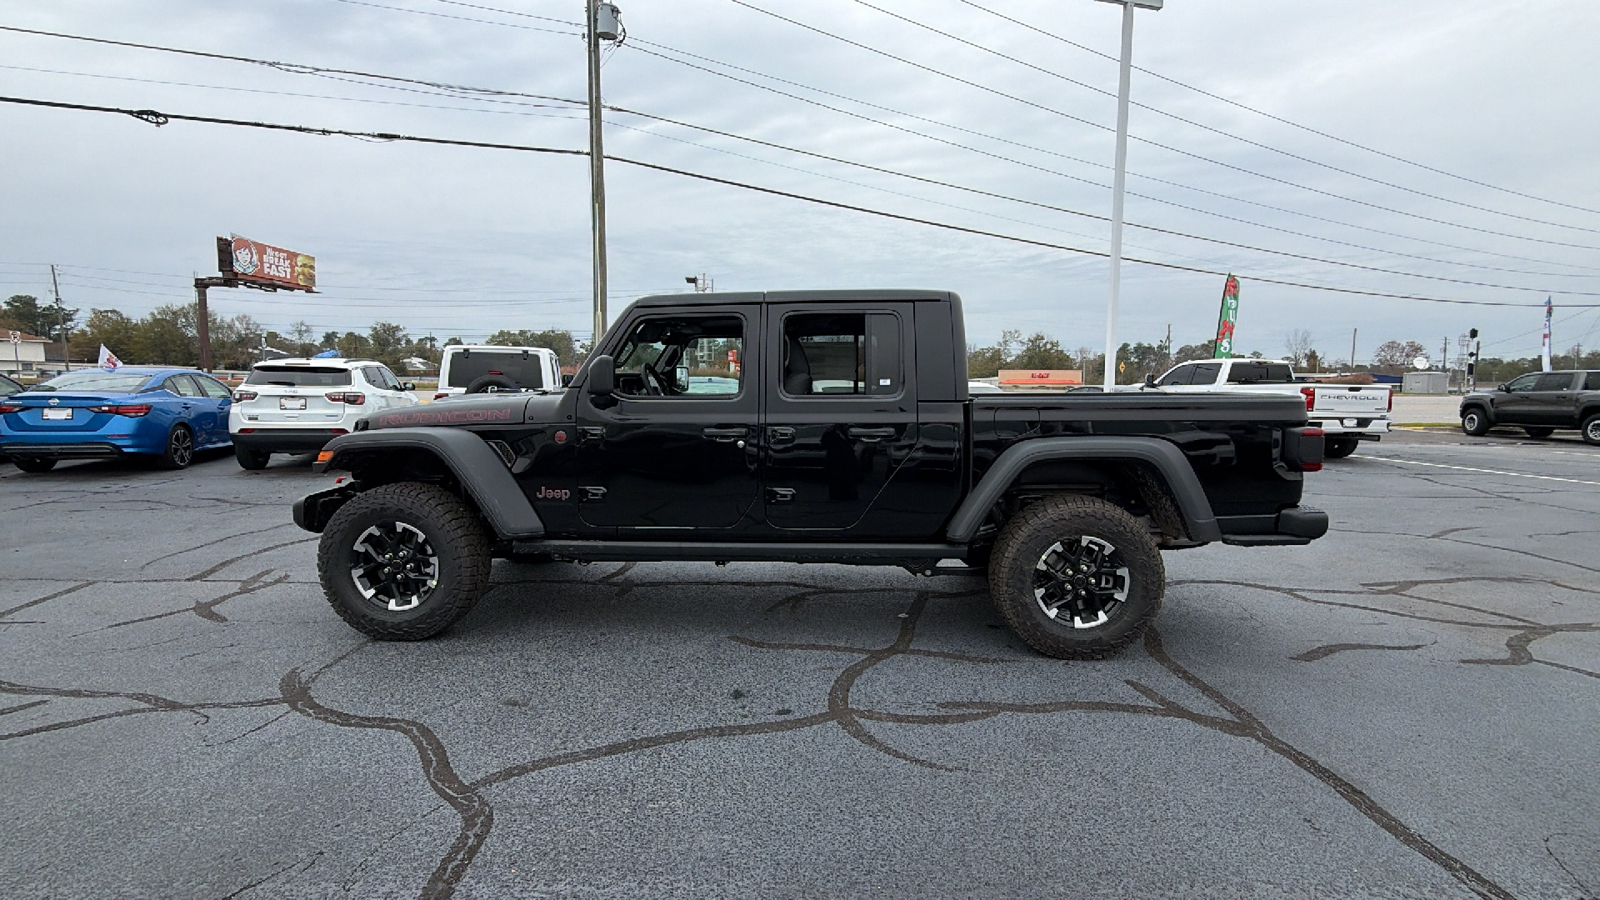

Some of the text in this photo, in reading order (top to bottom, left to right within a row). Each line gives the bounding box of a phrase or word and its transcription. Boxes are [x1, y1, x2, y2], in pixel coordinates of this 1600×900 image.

[263, 255, 290, 268] BREAK
[264, 263, 291, 278] FAST
[379, 408, 511, 426] RUBICON
[536, 486, 570, 501] Jeep
